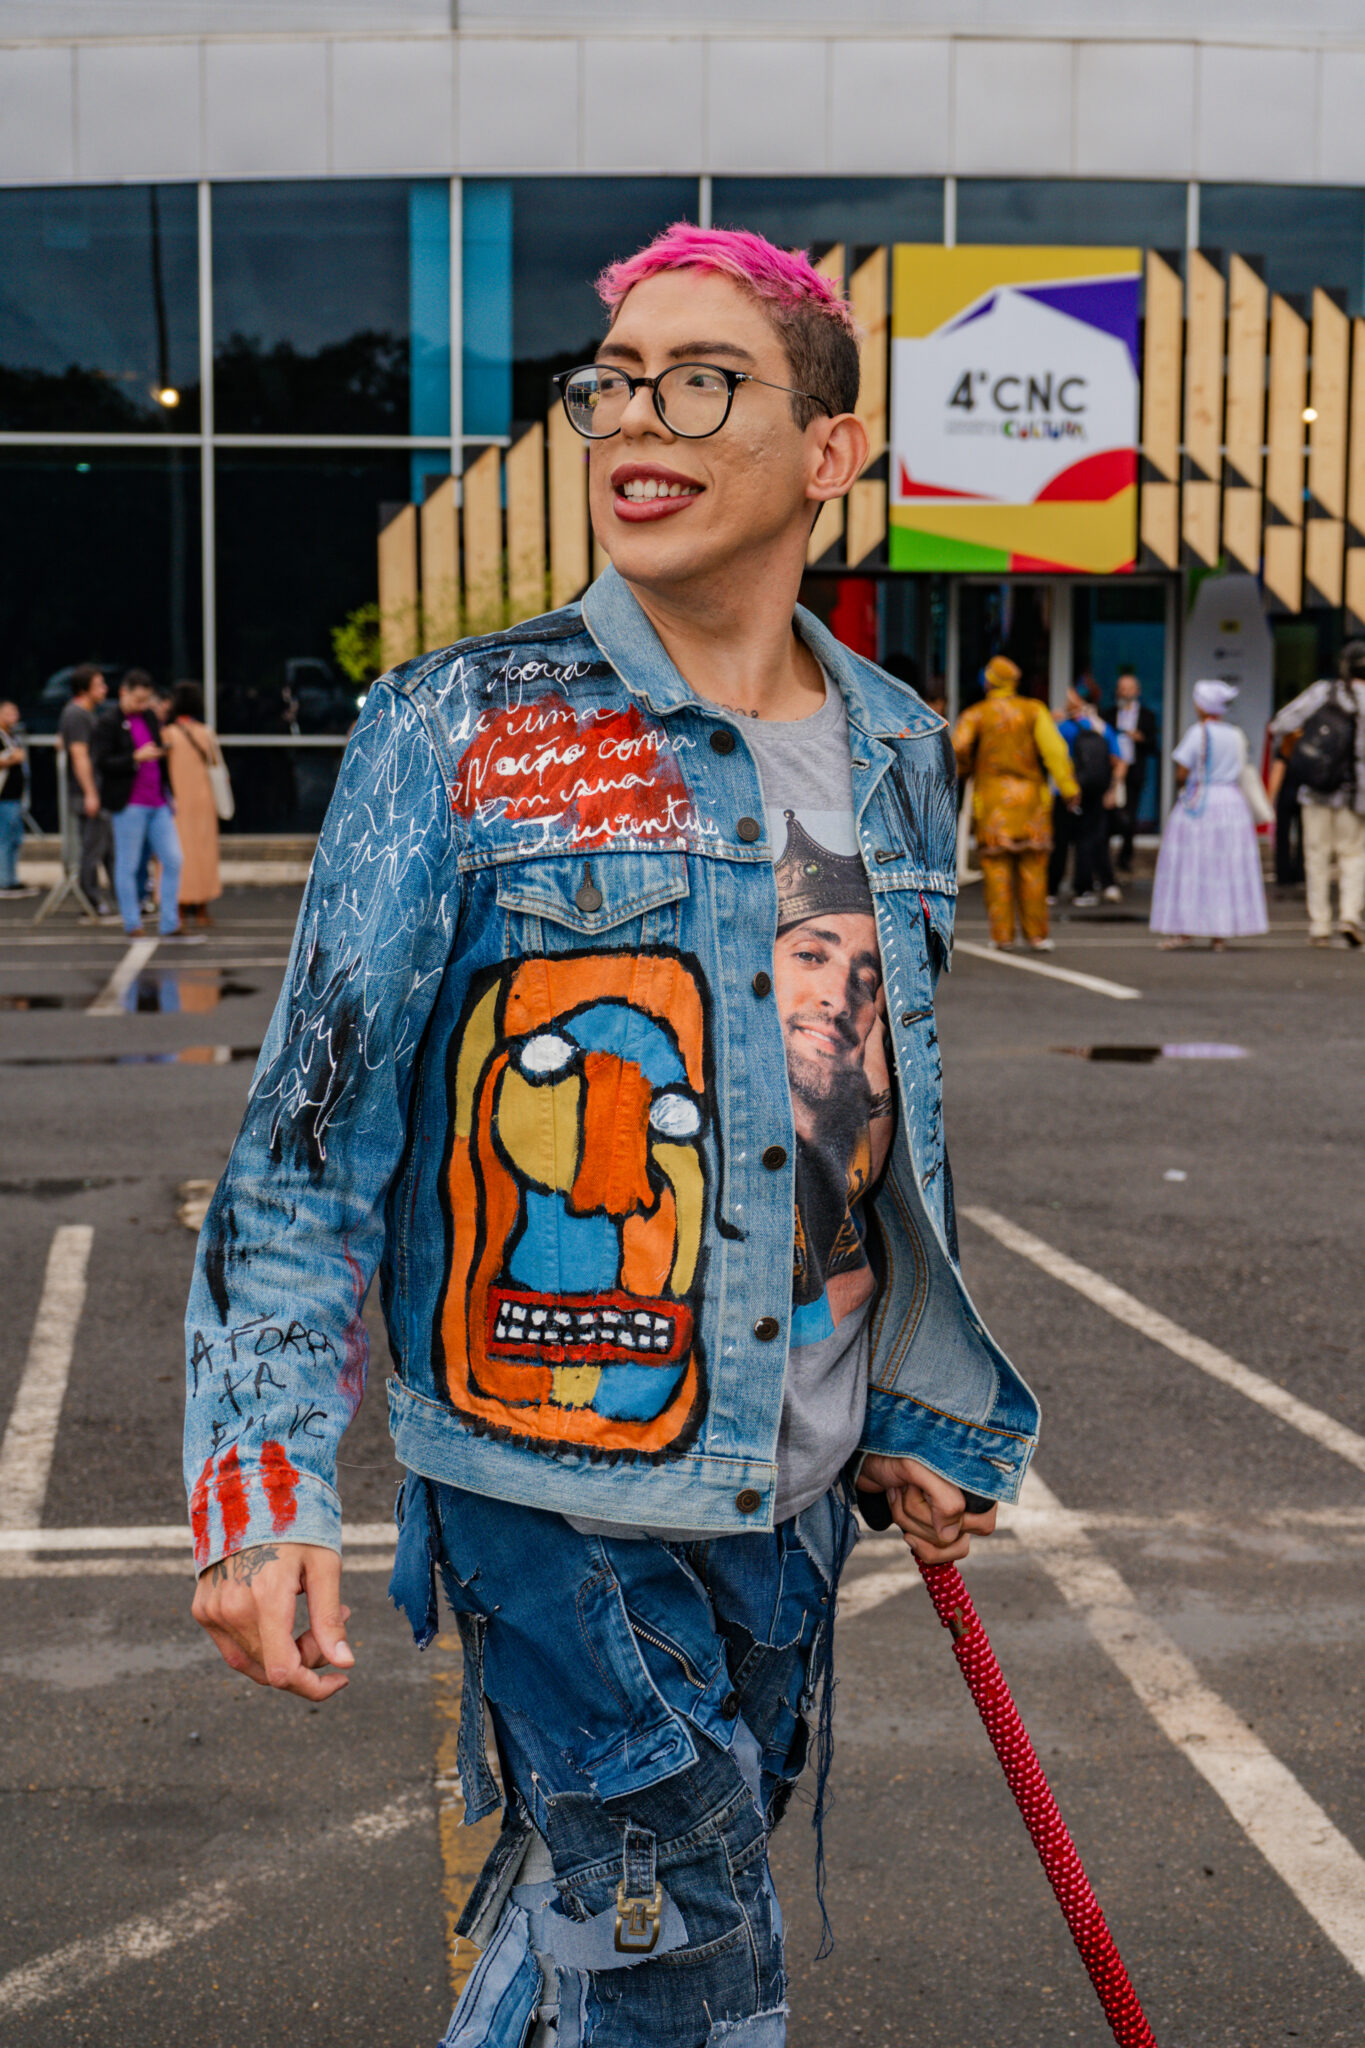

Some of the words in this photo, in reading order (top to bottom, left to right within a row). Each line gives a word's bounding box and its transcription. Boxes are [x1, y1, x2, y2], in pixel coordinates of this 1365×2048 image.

[992, 371, 1088, 413] CNC
[432, 657, 480, 708] A
[449, 707, 491, 744] de
[507, 703, 624, 735] uma
[464, 736, 587, 807] Nação
[560, 772, 656, 802] sua
[190, 1330, 214, 1397] A
[288, 1402, 328, 1440] VC
